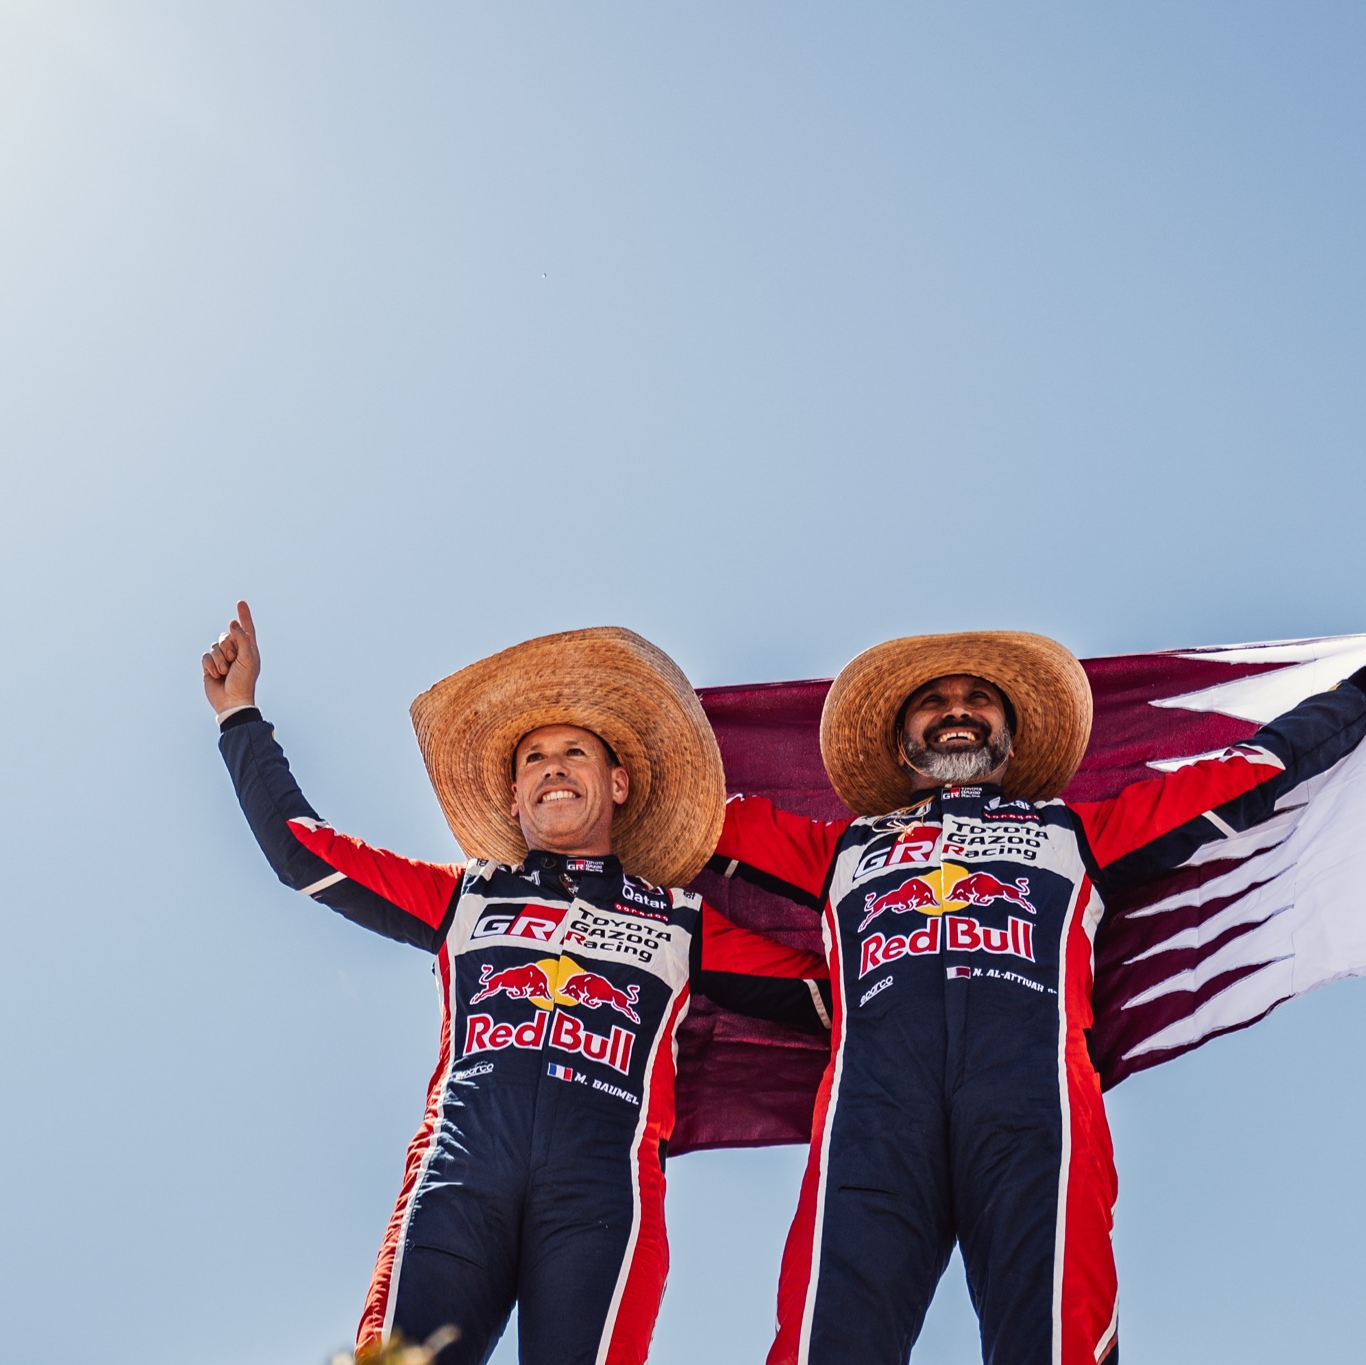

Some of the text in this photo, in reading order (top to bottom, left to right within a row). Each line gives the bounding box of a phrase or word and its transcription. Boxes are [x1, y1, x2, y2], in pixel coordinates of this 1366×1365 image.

[942, 788, 960, 800] GR
[947, 833, 1040, 848] GAZOO
[952, 820, 1049, 840] TOYOTA
[854, 840, 934, 881] GR
[942, 843, 1037, 860] Racing
[622, 884, 667, 910] Qatar
[473, 914, 557, 939] GR
[570, 920, 658, 950] GAZOO
[578, 907, 671, 942] TOYOTA
[561, 930, 653, 963] Racing
[858, 915, 1036, 981] Red Bull
[973, 968, 983, 977] N.
[463, 1008, 636, 1076] Red Bull
[574, 1072, 640, 1106] M. BAUMEL
